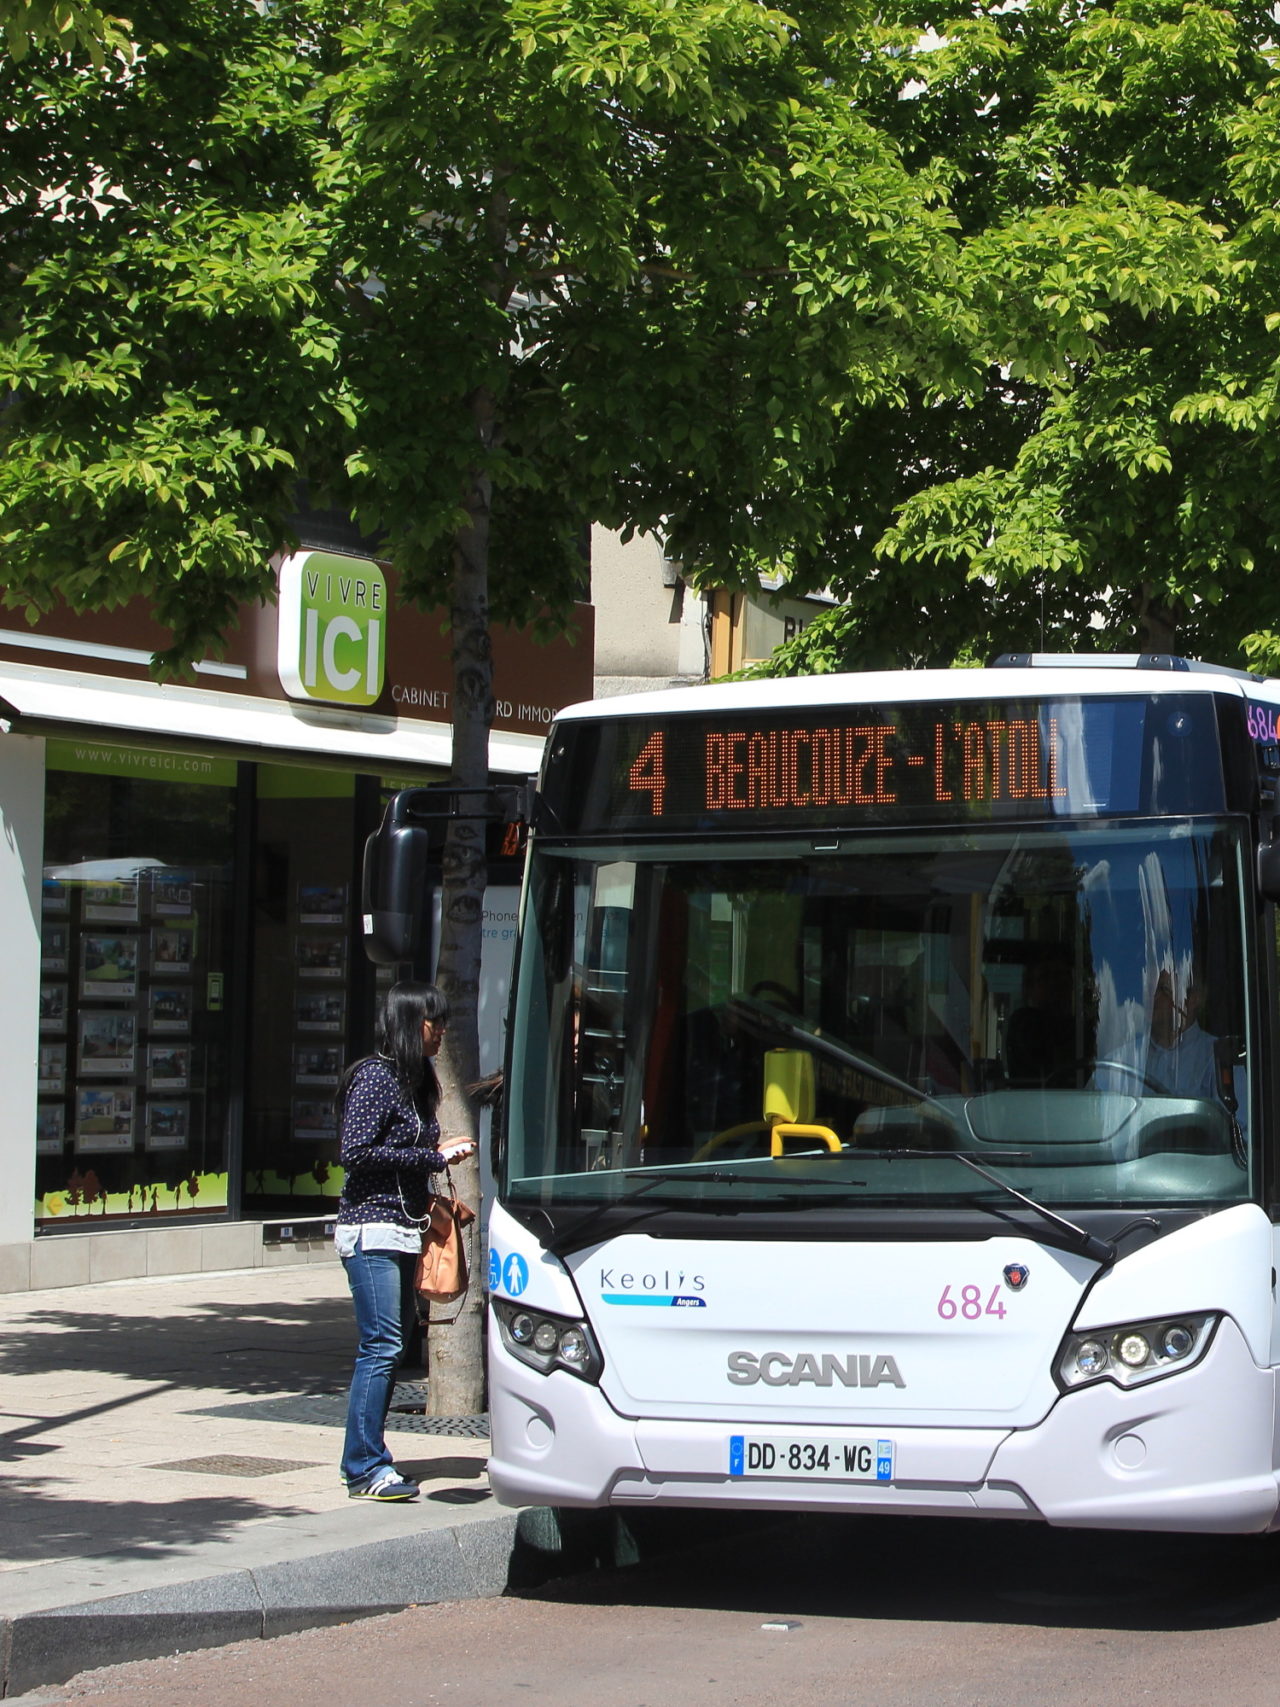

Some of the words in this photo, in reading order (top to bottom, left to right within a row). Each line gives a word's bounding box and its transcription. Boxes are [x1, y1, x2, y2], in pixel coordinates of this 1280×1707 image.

[306, 571, 383, 611] VIVRE
[304, 608, 380, 696] ICI
[391, 684, 449, 710] CABINET
[496, 700, 513, 718] RD
[1247, 704, 1278, 743] 684
[75, 748, 213, 773] www.vivreici.com
[628, 731, 666, 816] 4
[705, 725, 897, 810] BEAUCOUZE
[934, 718, 1068, 802] L'ATOLL
[600, 1268, 705, 1291] Keolis
[676, 1297, 700, 1308] Angers
[937, 1284, 1008, 1320] 684
[726, 1350, 907, 1389] SCANIA
[733, 1458, 741, 1468] F
[748, 1442, 872, 1473] DD-834-WG
[878, 1460, 890, 1475] 49
